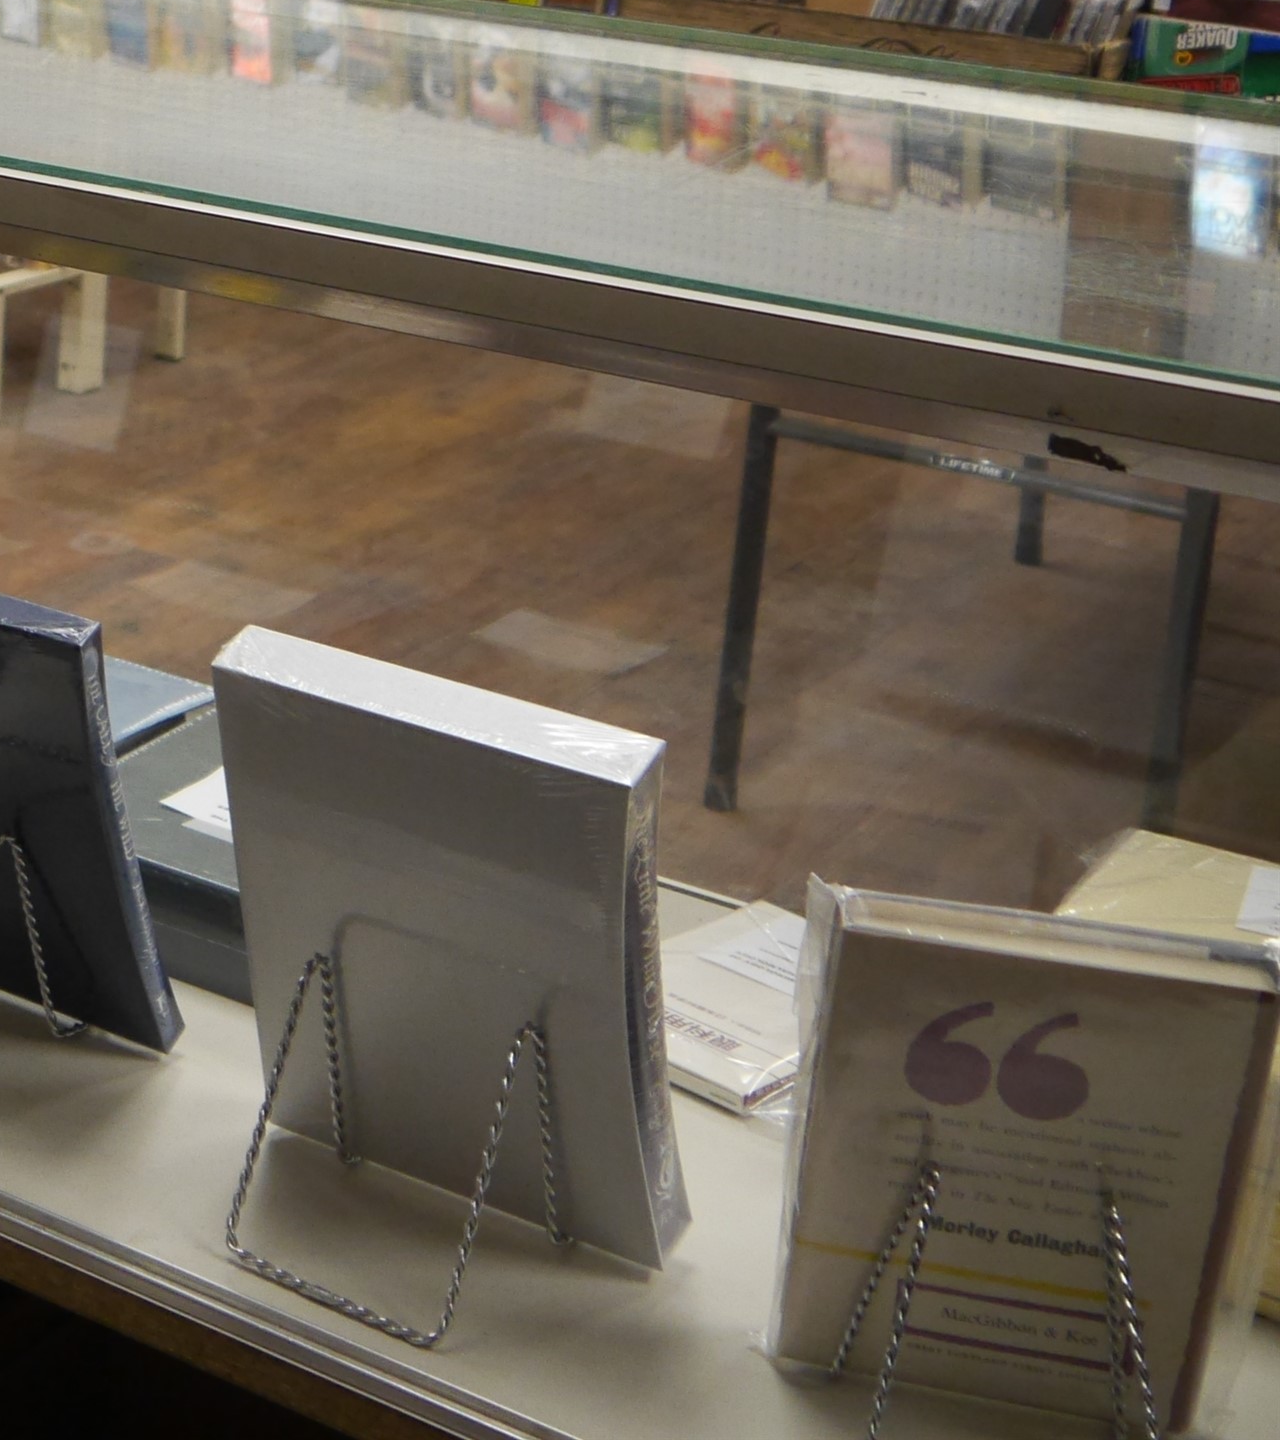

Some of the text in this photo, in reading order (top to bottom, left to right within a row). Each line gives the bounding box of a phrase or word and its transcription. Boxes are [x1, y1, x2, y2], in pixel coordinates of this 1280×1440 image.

[1176, 26, 1239, 51] QUAKER
[928, 1216, 998, 1243] Morley
[941, 1307, 1099, 1347] MacGibbon & Kee
